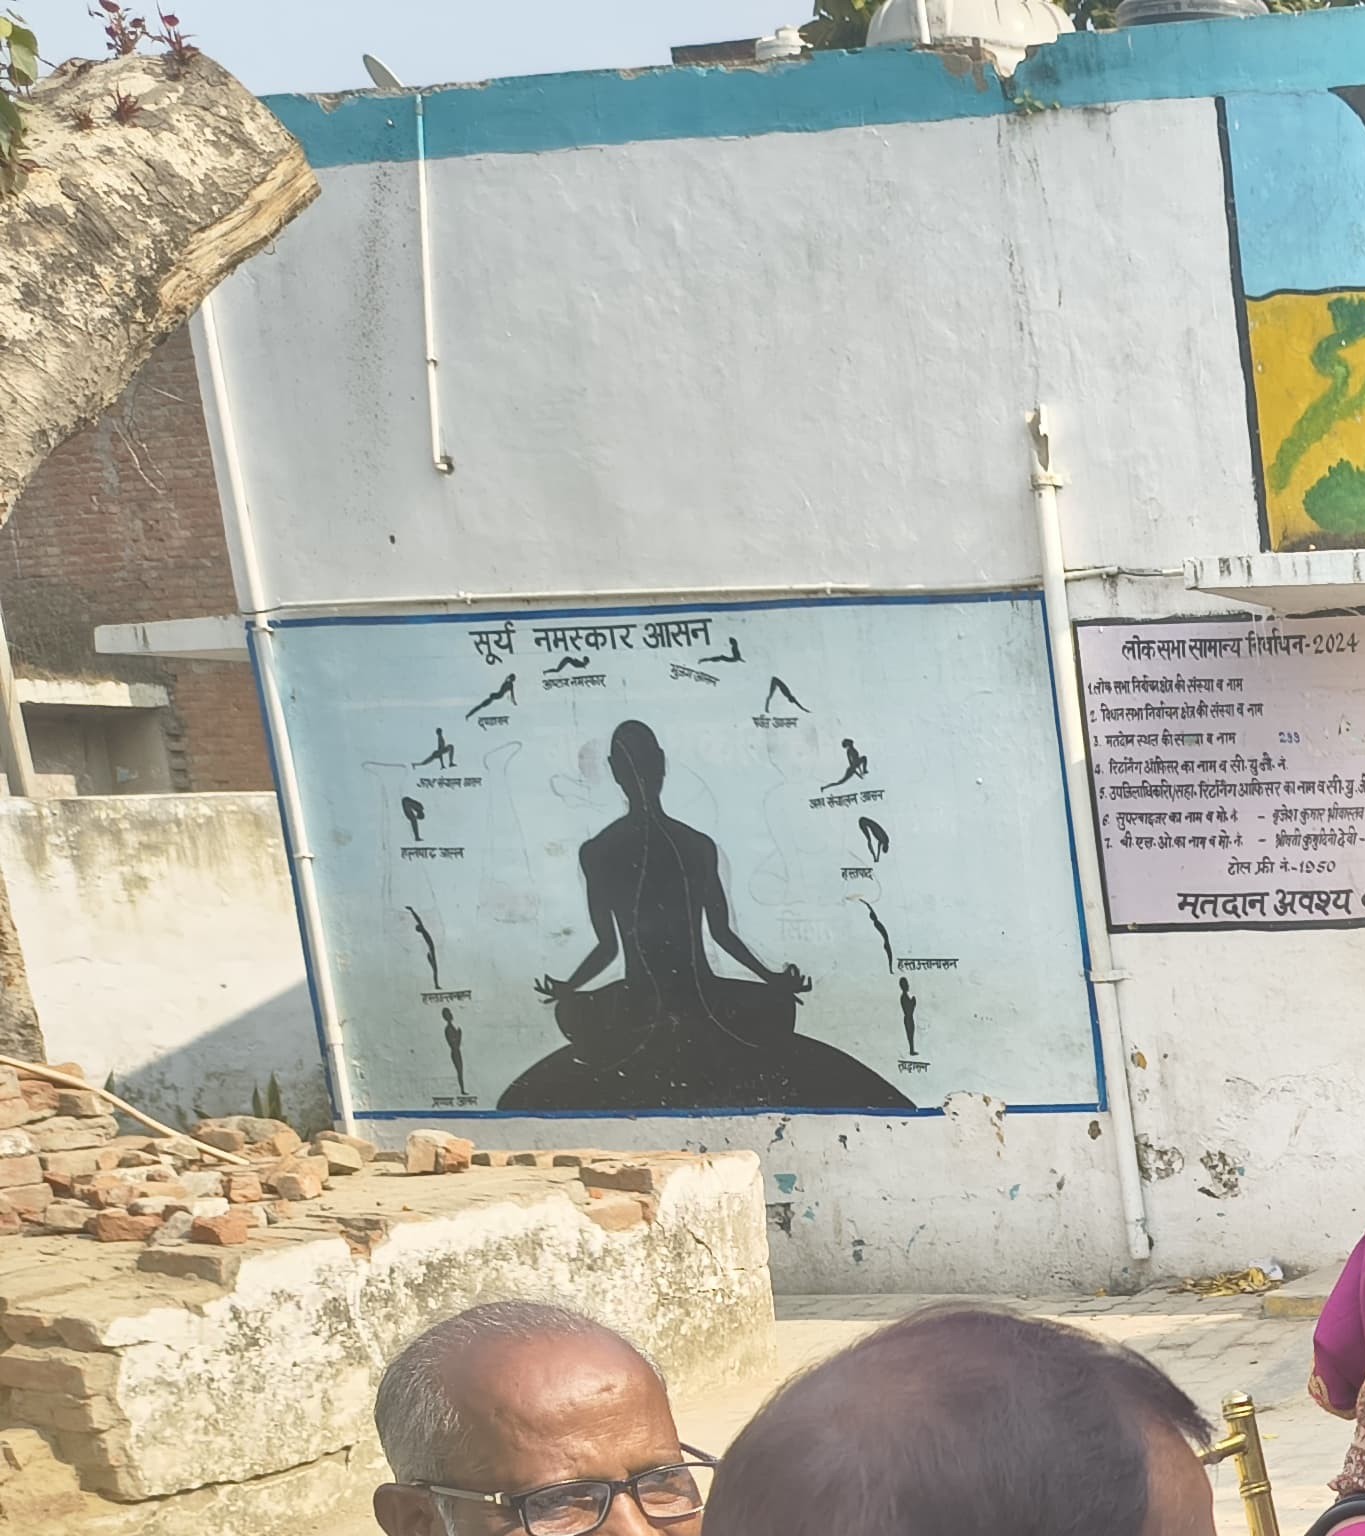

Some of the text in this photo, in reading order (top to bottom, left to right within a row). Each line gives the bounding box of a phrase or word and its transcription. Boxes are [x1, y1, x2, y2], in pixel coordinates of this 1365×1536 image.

[473, 618, 712, 665] सूर्य नमस्कार आसन
[1122, 634, 1156, 661] लोक
[1156, 638, 1186, 661] सभा
[1188, 637, 1244, 661] सामान्य
[1197, 759, 1217, 774] नाम
[1297, 780, 1316, 796] नाम
[1228, 856, 1251, 876] टोल
[1254, 856, 1274, 876] फ्री
[1177, 891, 1269, 919] मतदान
[1273, 888, 1353, 917] अवश्य
